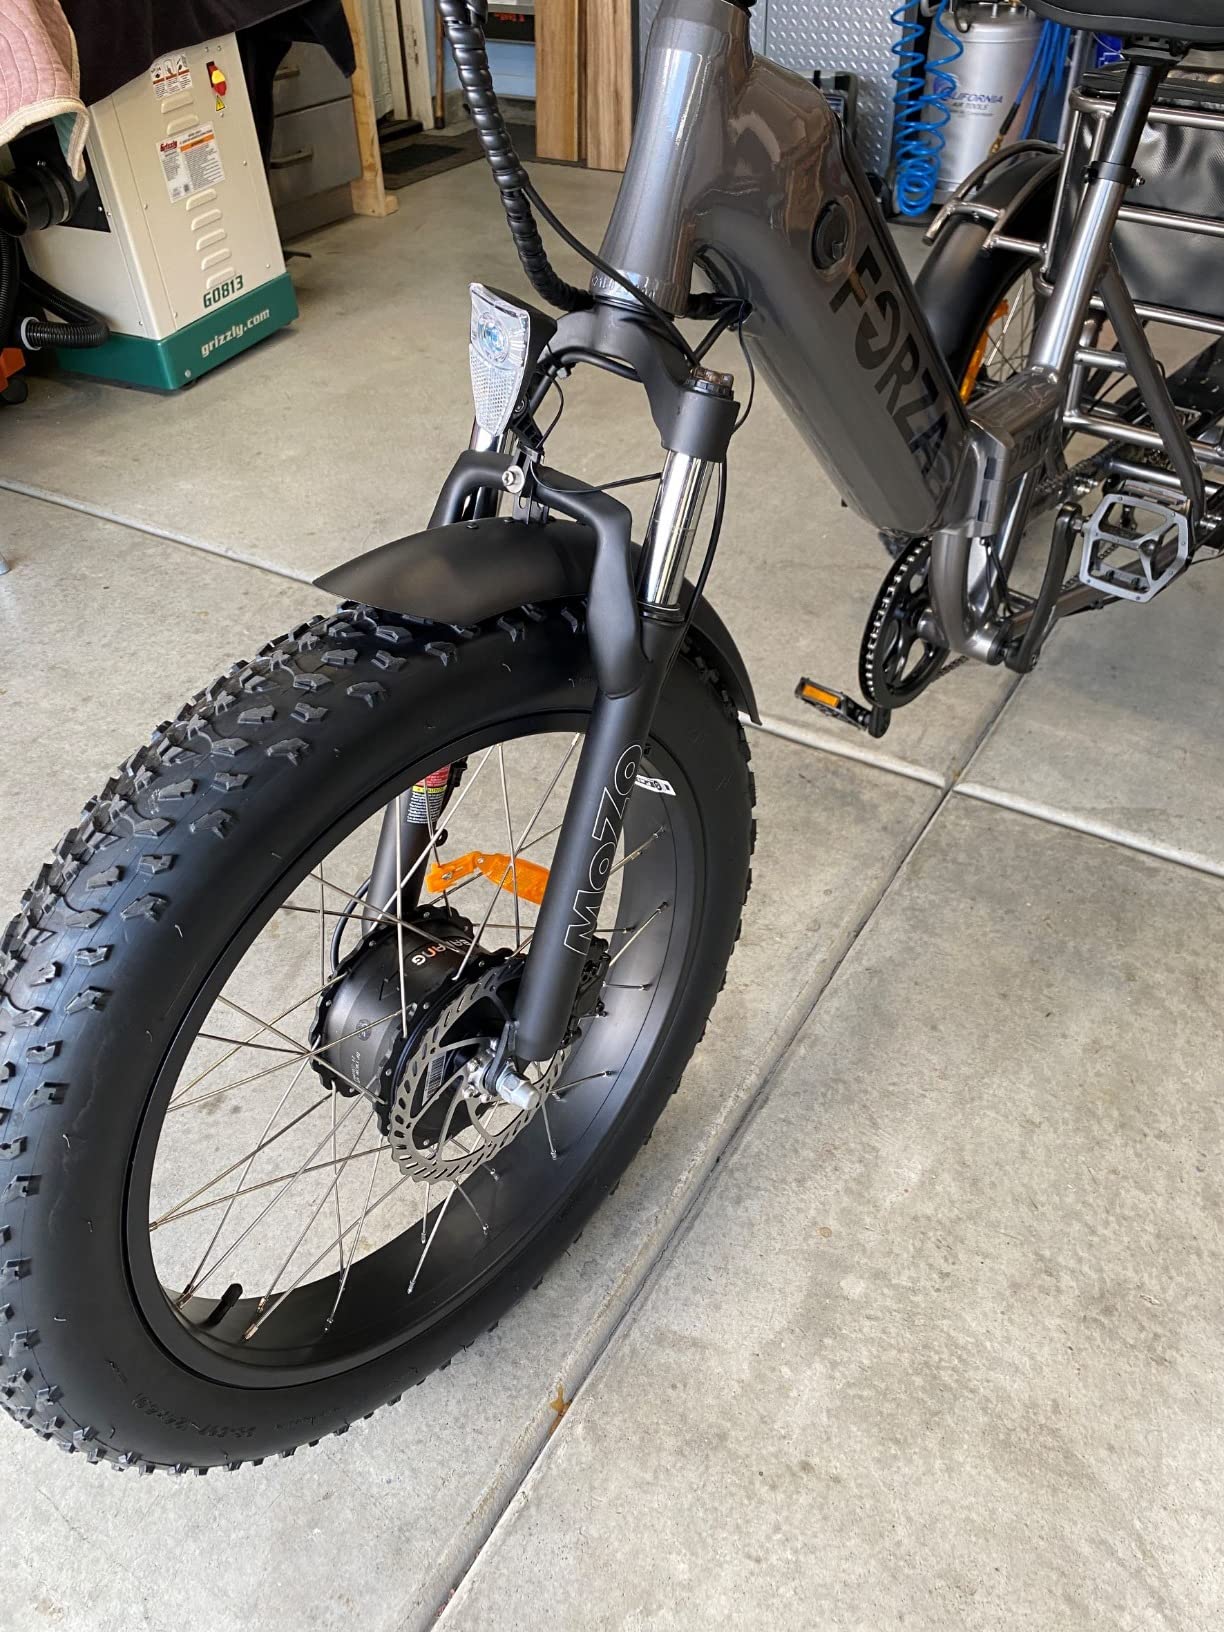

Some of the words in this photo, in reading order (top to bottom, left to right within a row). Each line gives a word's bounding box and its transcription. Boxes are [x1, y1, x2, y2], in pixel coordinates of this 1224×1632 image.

[203, 275, 243, 308] G0813
[201, 309, 270, 358] grizzly.com
[829, 245, 948, 477] FORZA
